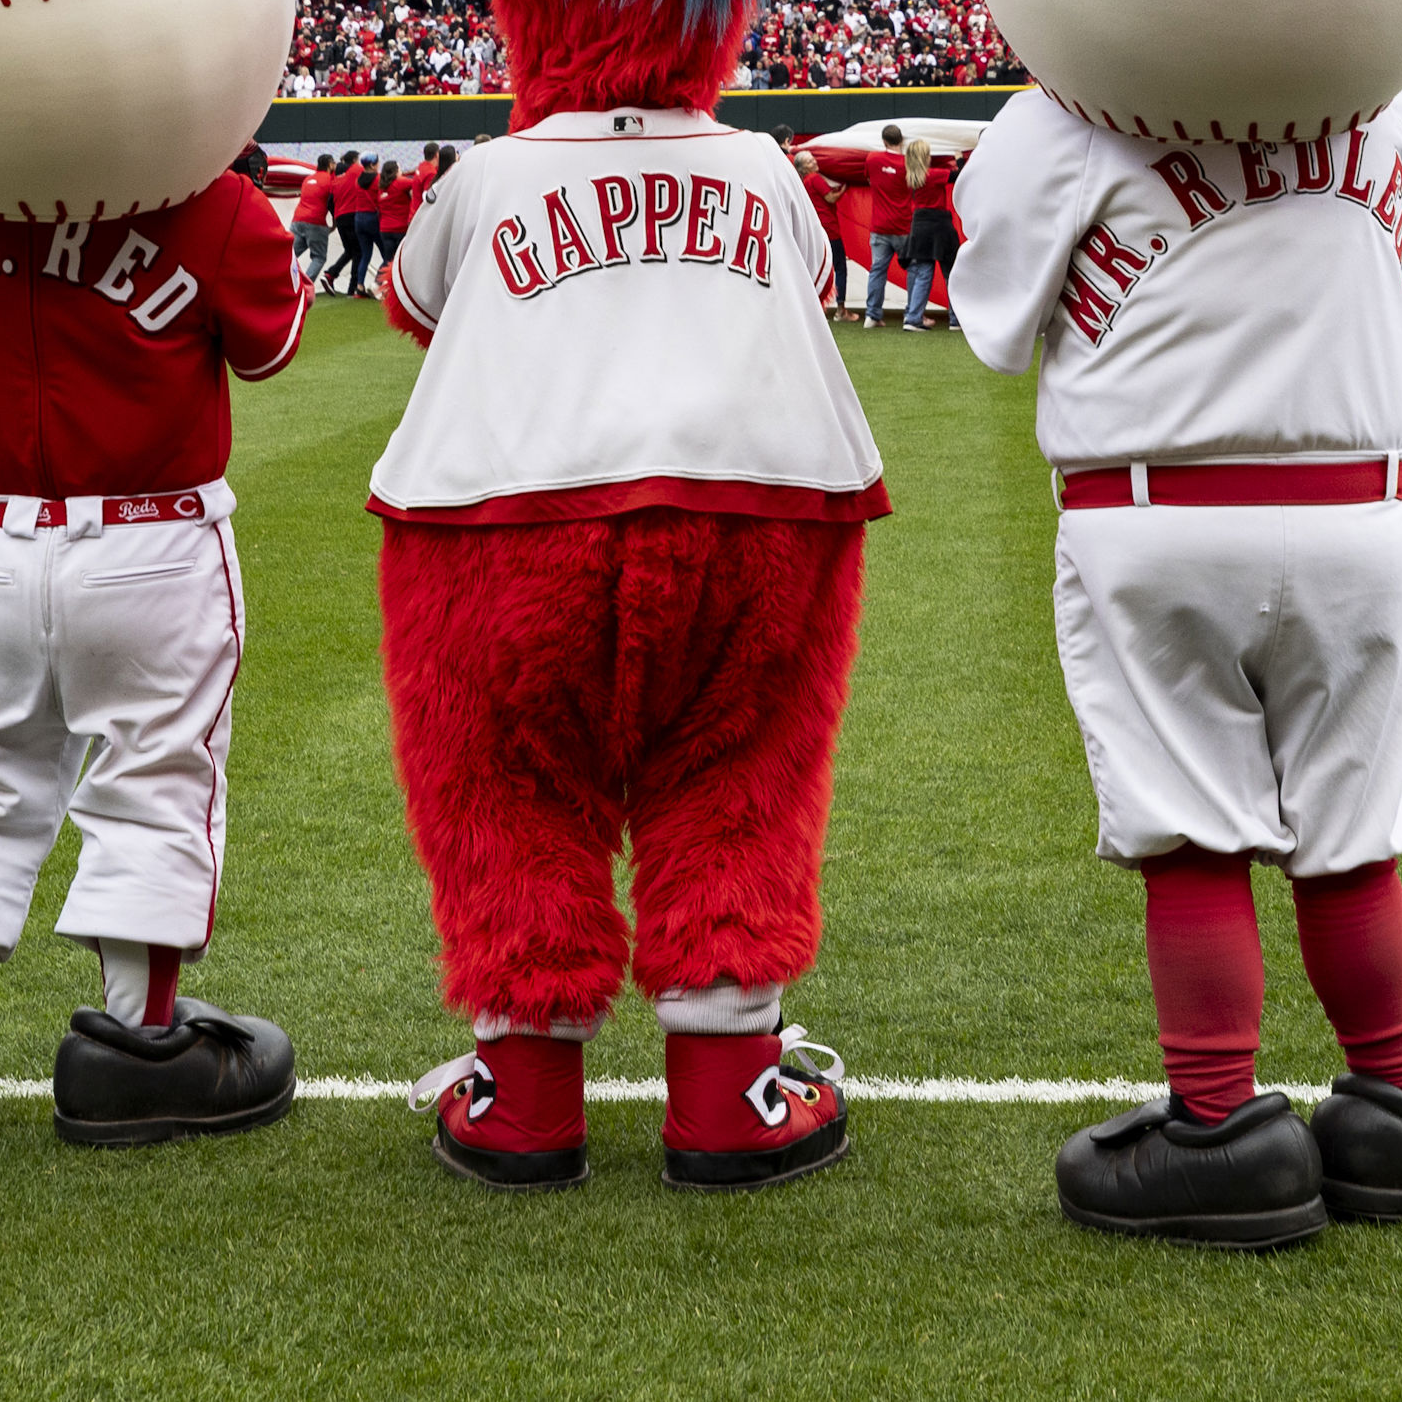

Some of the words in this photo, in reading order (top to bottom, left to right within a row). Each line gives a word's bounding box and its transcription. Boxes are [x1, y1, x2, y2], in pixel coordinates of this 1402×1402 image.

[41, 222, 199, 333] RED
[491, 171, 773, 300] GAPPER
[1061, 221, 1169, 348] MR.
[118, 500, 160, 522] Reds
[173, 495, 198, 517] C
